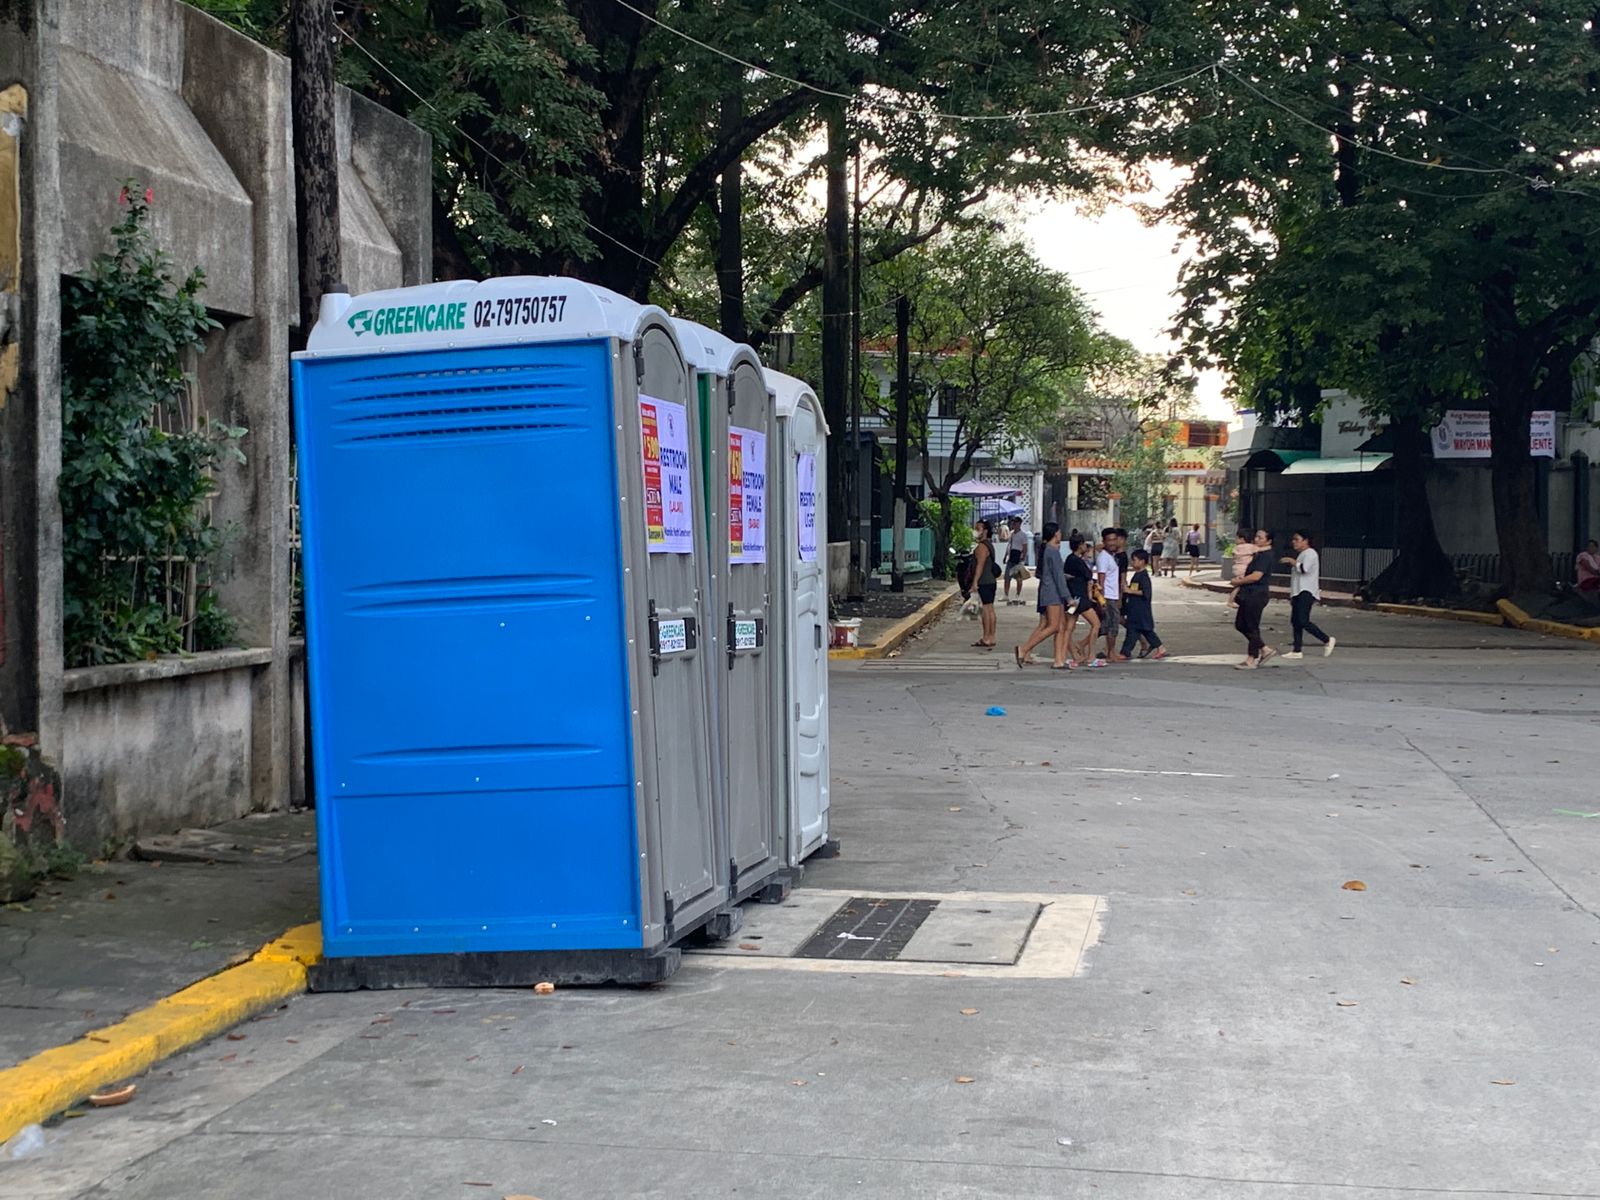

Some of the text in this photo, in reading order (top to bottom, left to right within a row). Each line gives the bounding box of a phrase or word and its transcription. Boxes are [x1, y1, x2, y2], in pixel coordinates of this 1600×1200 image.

[373, 295, 568, 337] GREENCARE 02-79750757
[1453, 438, 1553, 451] MAYOR MAN UENTE
[660, 446, 688, 470] RESTROOM
[668, 474, 682, 495] MALE
[742, 471, 765, 490] RESTROOM
[746, 494, 762, 513] FEMALE
